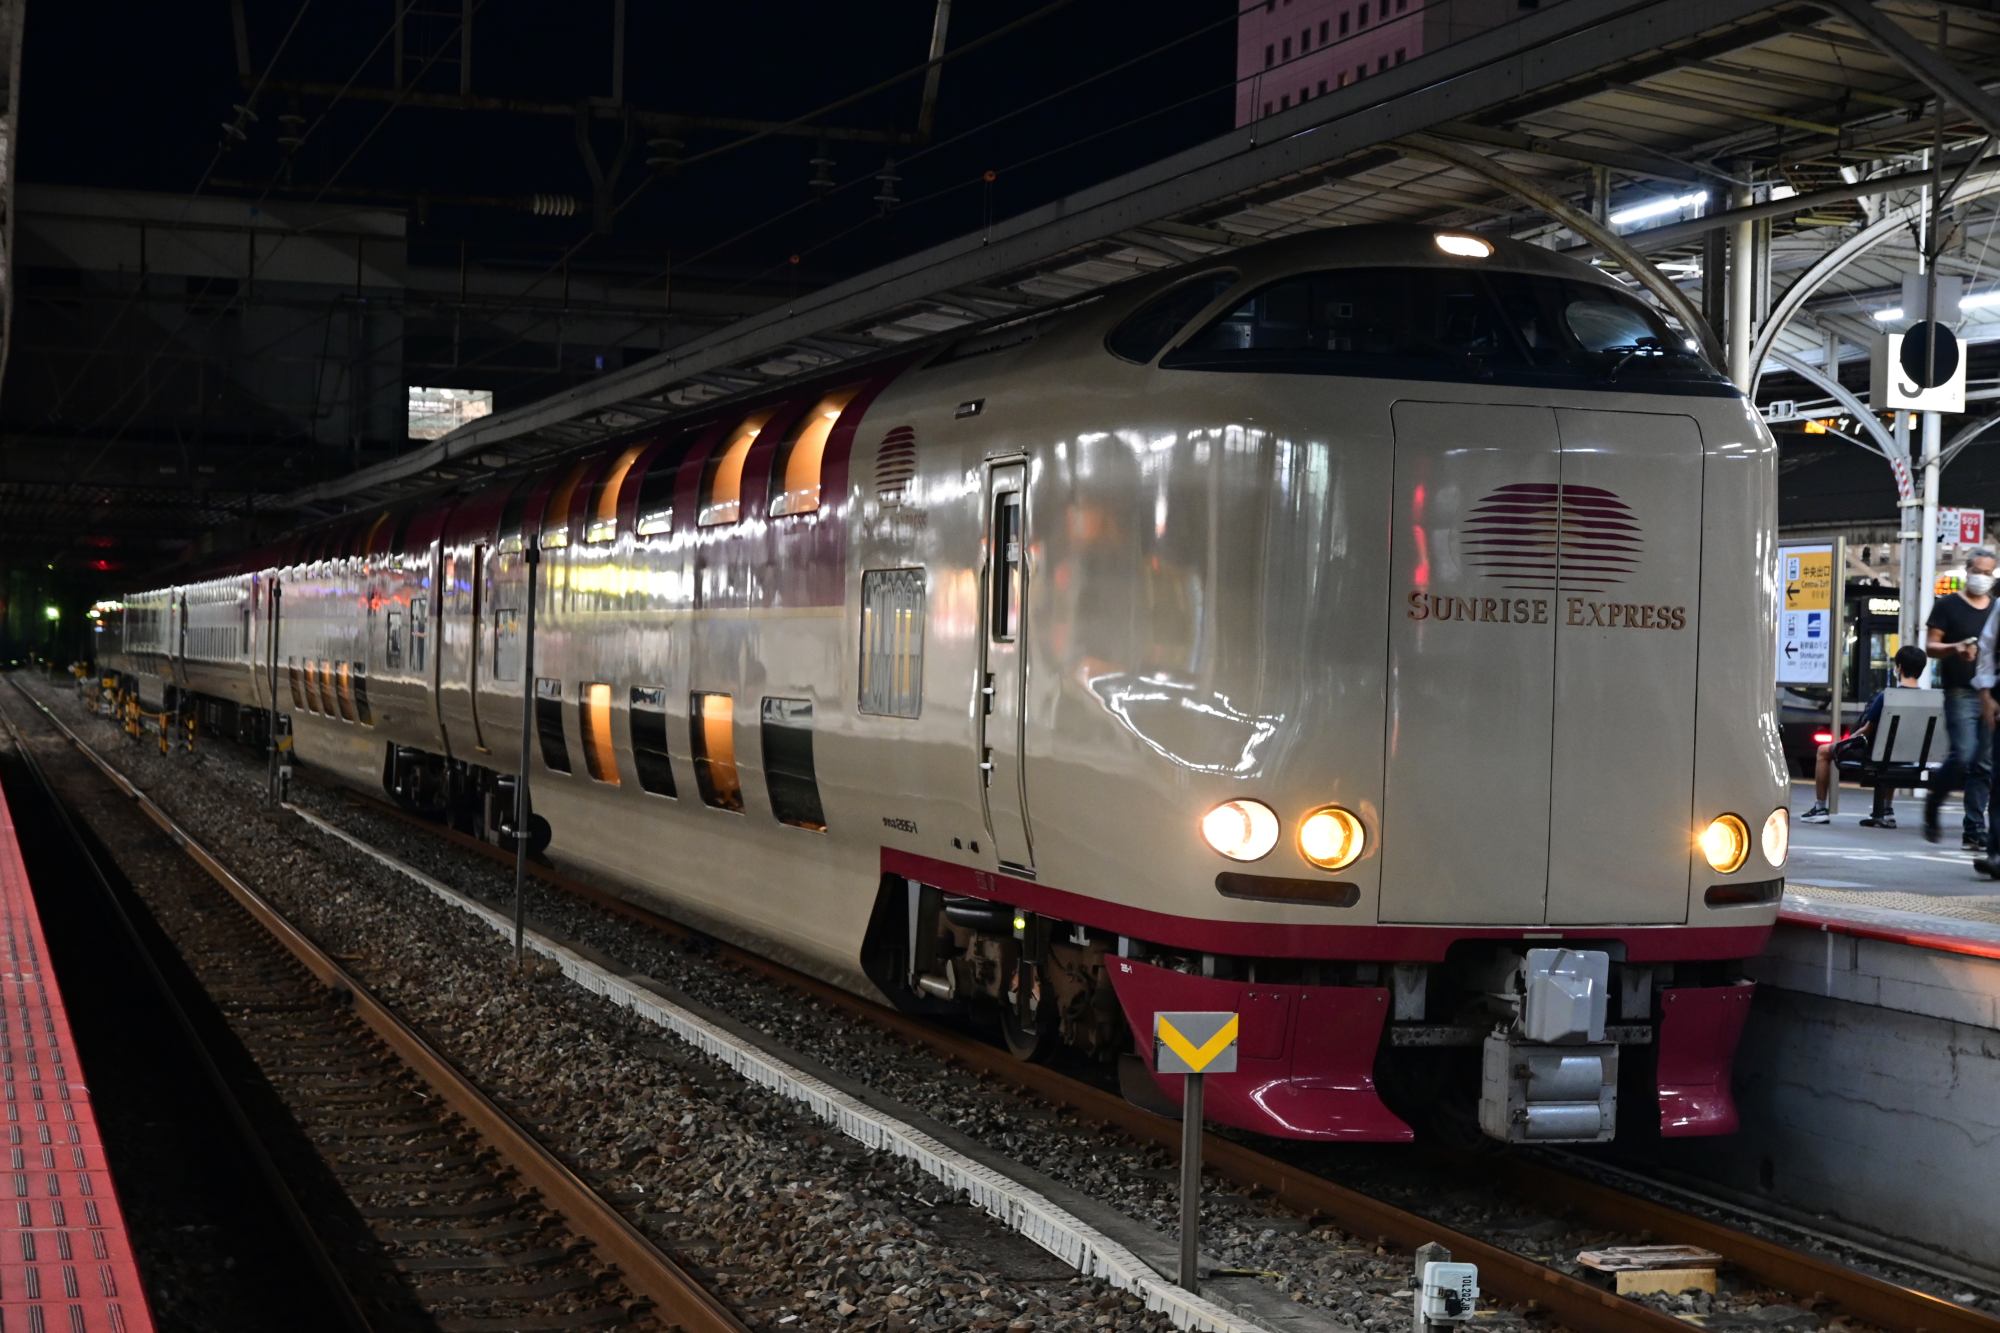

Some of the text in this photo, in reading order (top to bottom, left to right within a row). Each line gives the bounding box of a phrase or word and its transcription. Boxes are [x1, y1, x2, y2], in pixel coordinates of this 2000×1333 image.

[1962, 515, 1980, 526] SOS
[1803, 565, 1831, 577] 中央出口
[1407, 590, 1688, 631] SUNRISE EXPRESS
